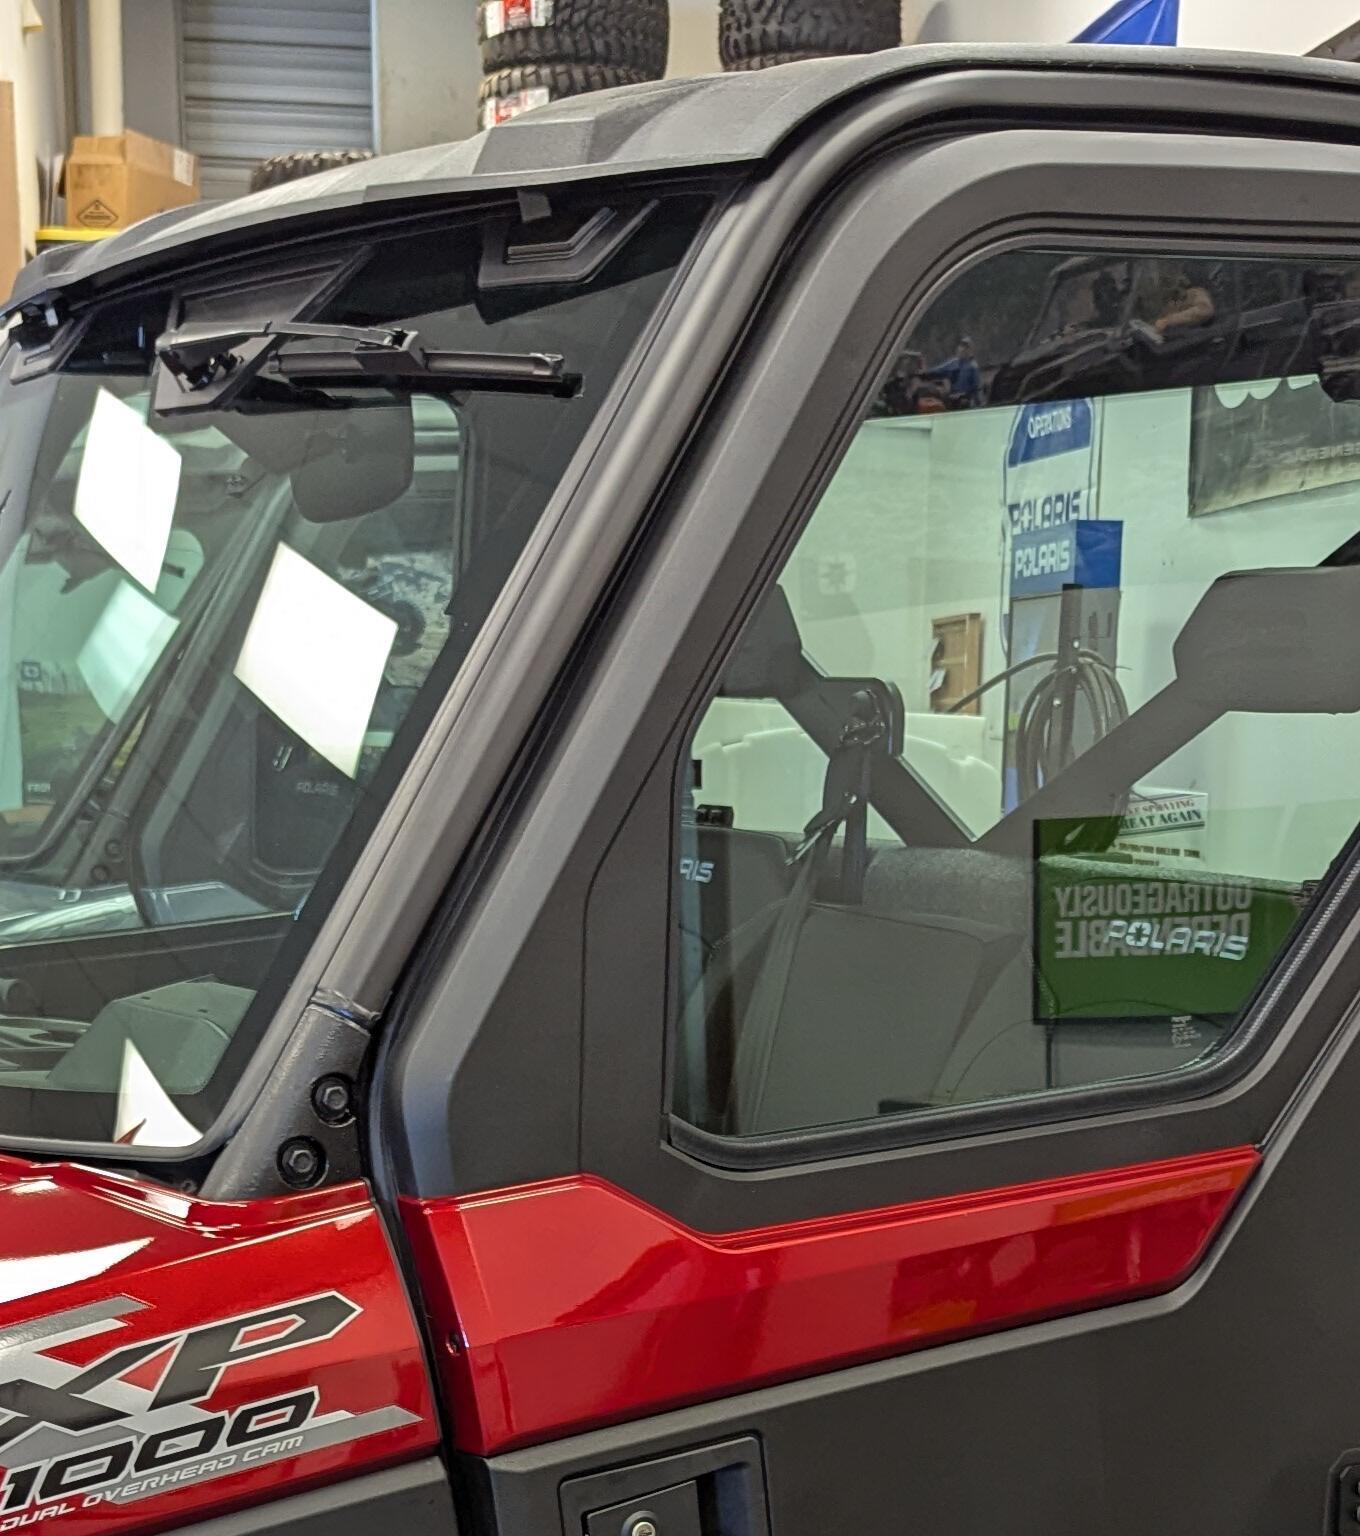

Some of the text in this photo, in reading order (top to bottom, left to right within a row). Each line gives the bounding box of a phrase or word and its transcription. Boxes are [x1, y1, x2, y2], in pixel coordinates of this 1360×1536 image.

[1015, 540, 1071, 579] POLARIS
[1120, 808, 1203, 830] REAT AGAIN
[1104, 919, 1249, 961] POLARIS
[83, 1454, 238, 1507] OVERHEAD
[242, 1435, 304, 1465] CAM
